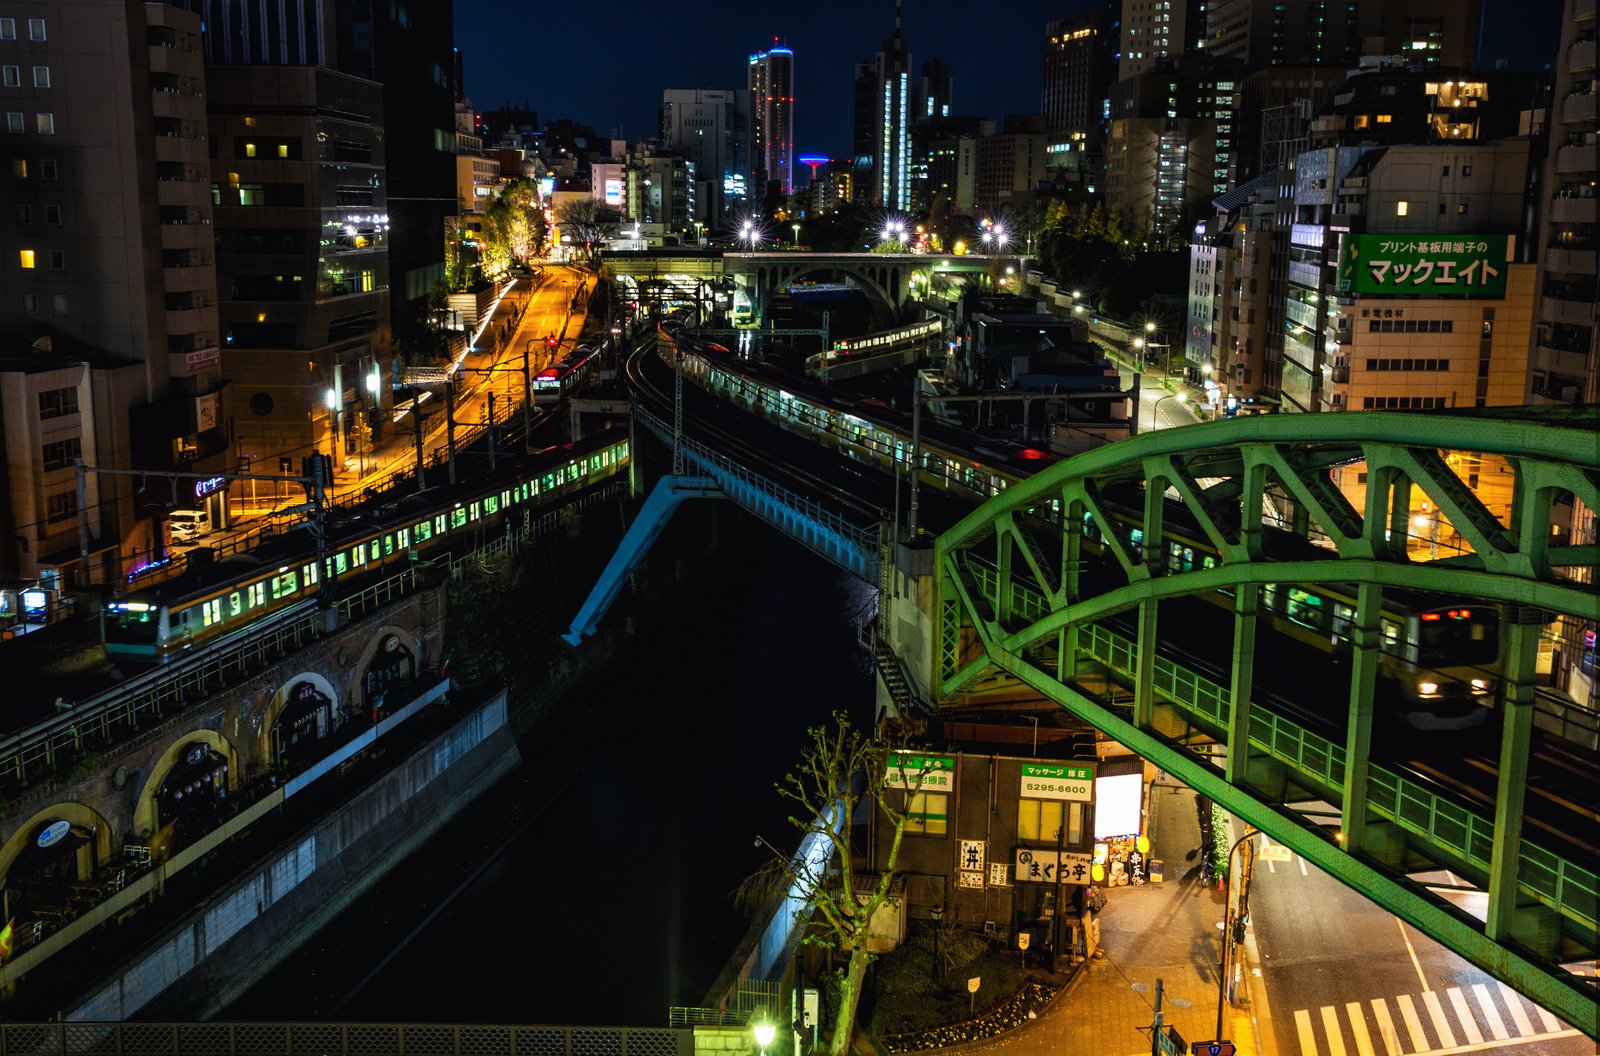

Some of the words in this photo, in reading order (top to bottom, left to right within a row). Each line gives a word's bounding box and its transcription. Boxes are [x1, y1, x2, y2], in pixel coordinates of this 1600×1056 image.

[1380, 241, 1488, 254] プリント基板用端子の
[1368, 259, 1499, 285] マックエイト
[1027, 767, 1064, 776] マッサージ
[1026, 783, 1086, 794] 5295-6600
[1030, 861, 1087, 881] まぐろ亭
[1211, 1046, 1220, 1054] 17
